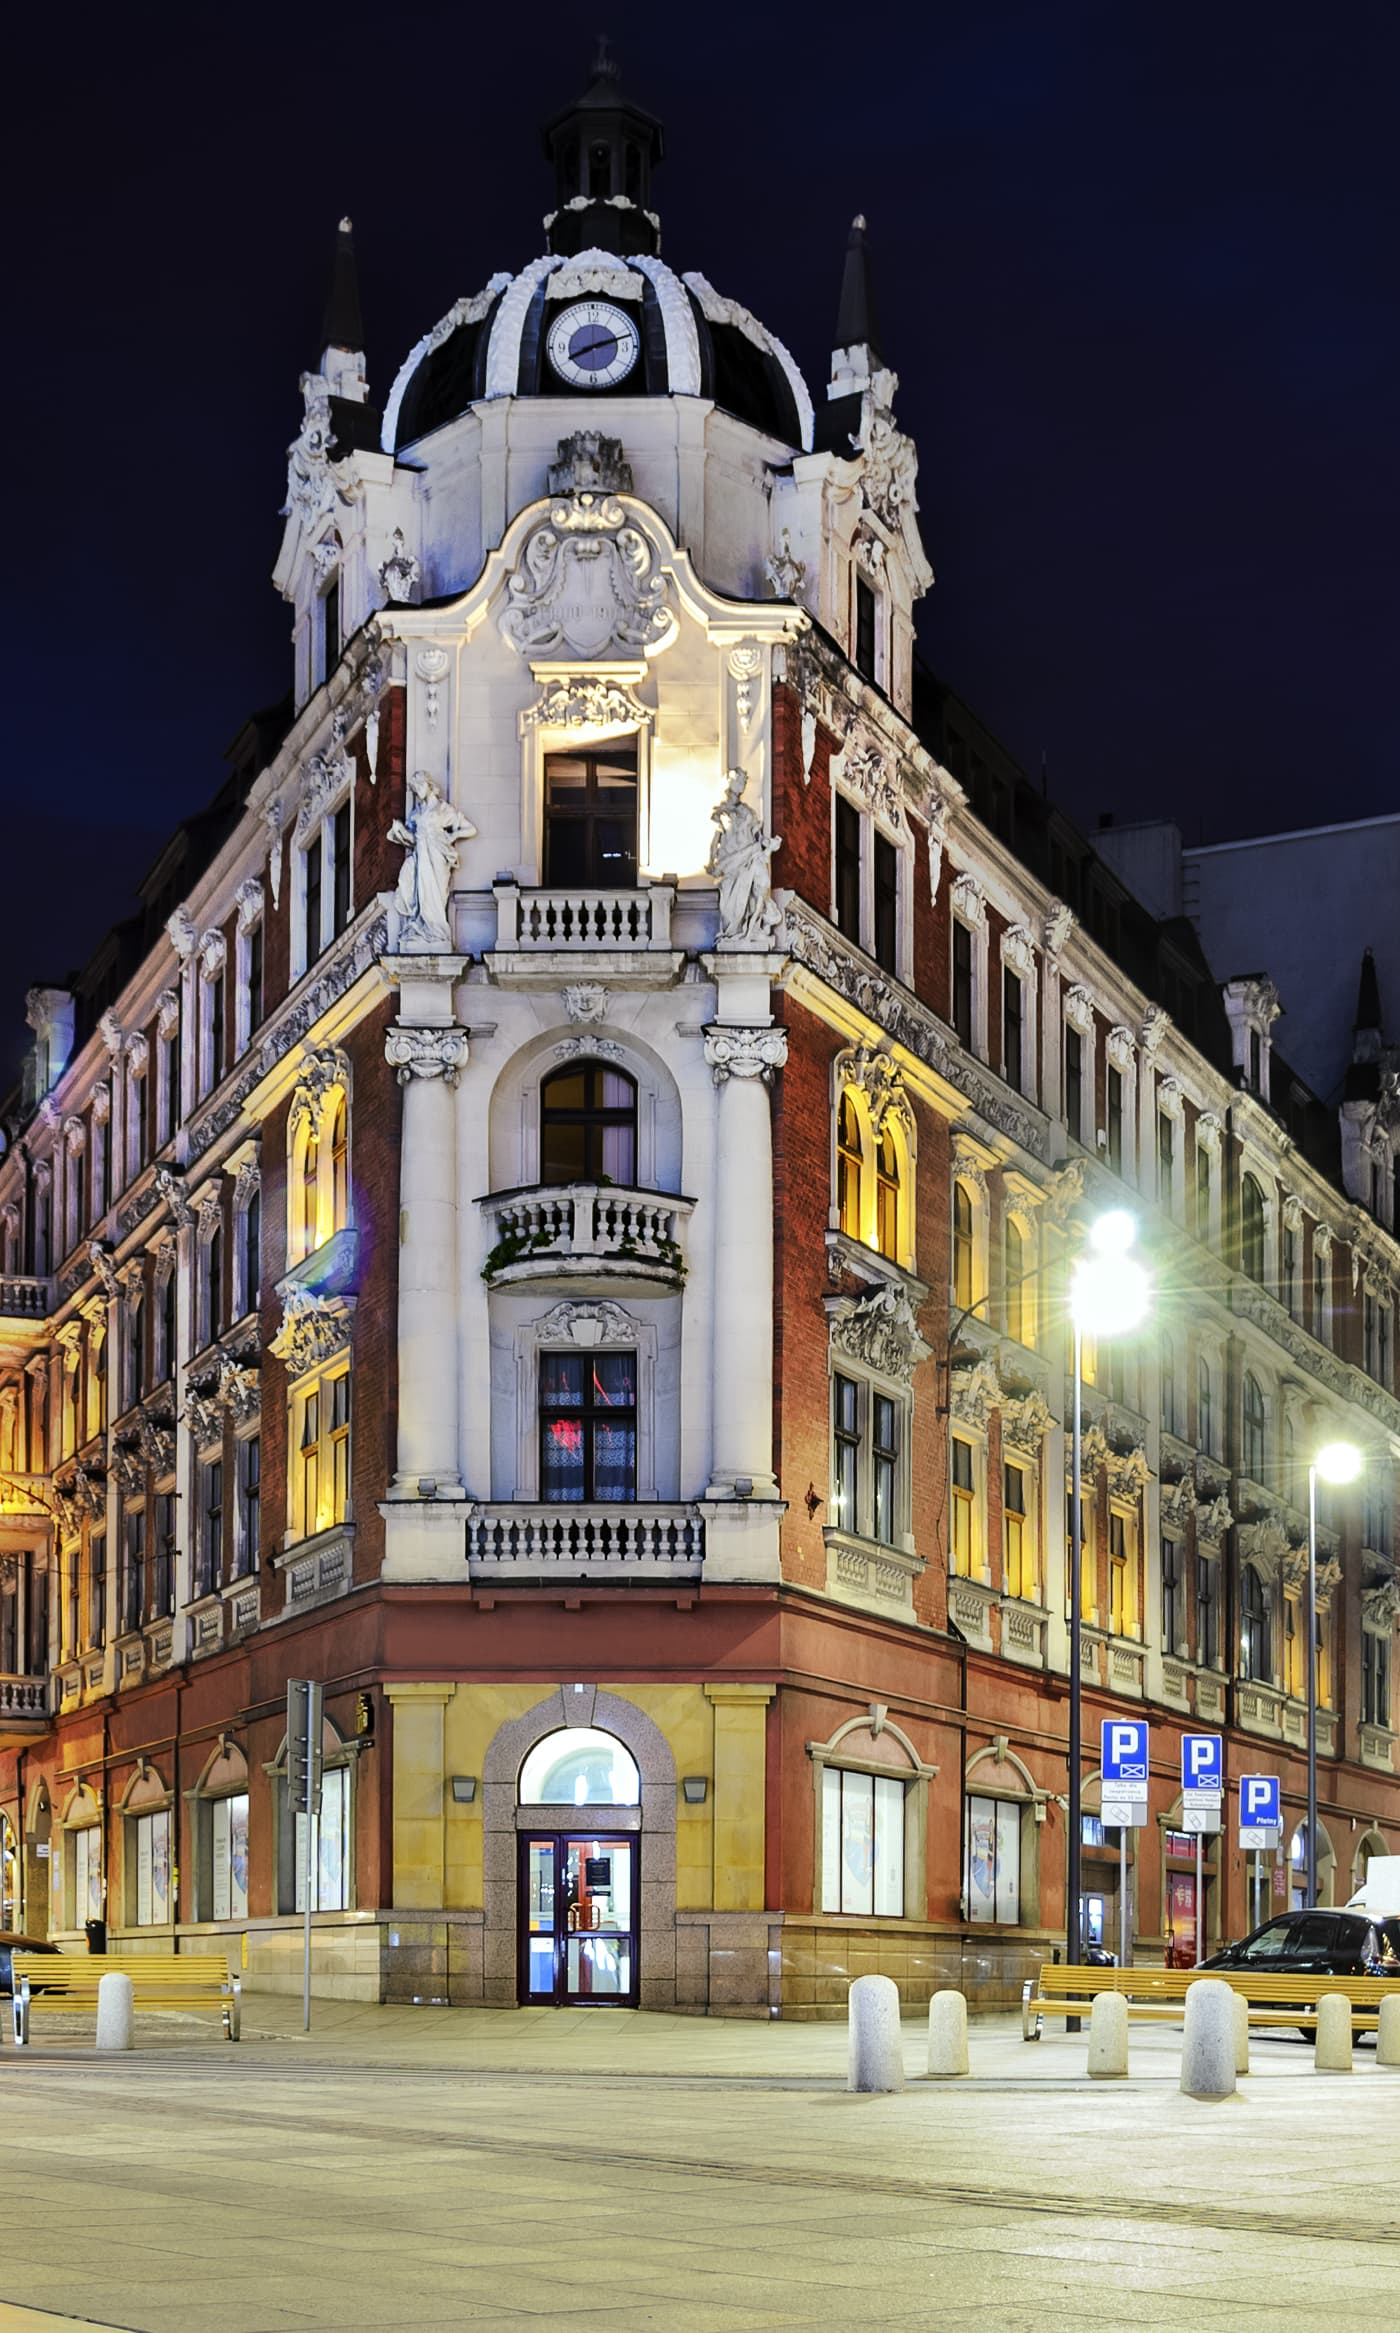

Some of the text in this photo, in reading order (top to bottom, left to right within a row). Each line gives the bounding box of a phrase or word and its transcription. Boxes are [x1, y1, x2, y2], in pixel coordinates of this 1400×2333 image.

[587, 311, 599, 322] 12
[558, 343, 566, 353] 9
[621, 342, 628, 353] 3
[589, 373, 598, 385] 6
[1112, 1726, 1138, 1764] P
[1191, 1740, 1214, 1774] P
[1248, 1780, 1270, 1813] P
